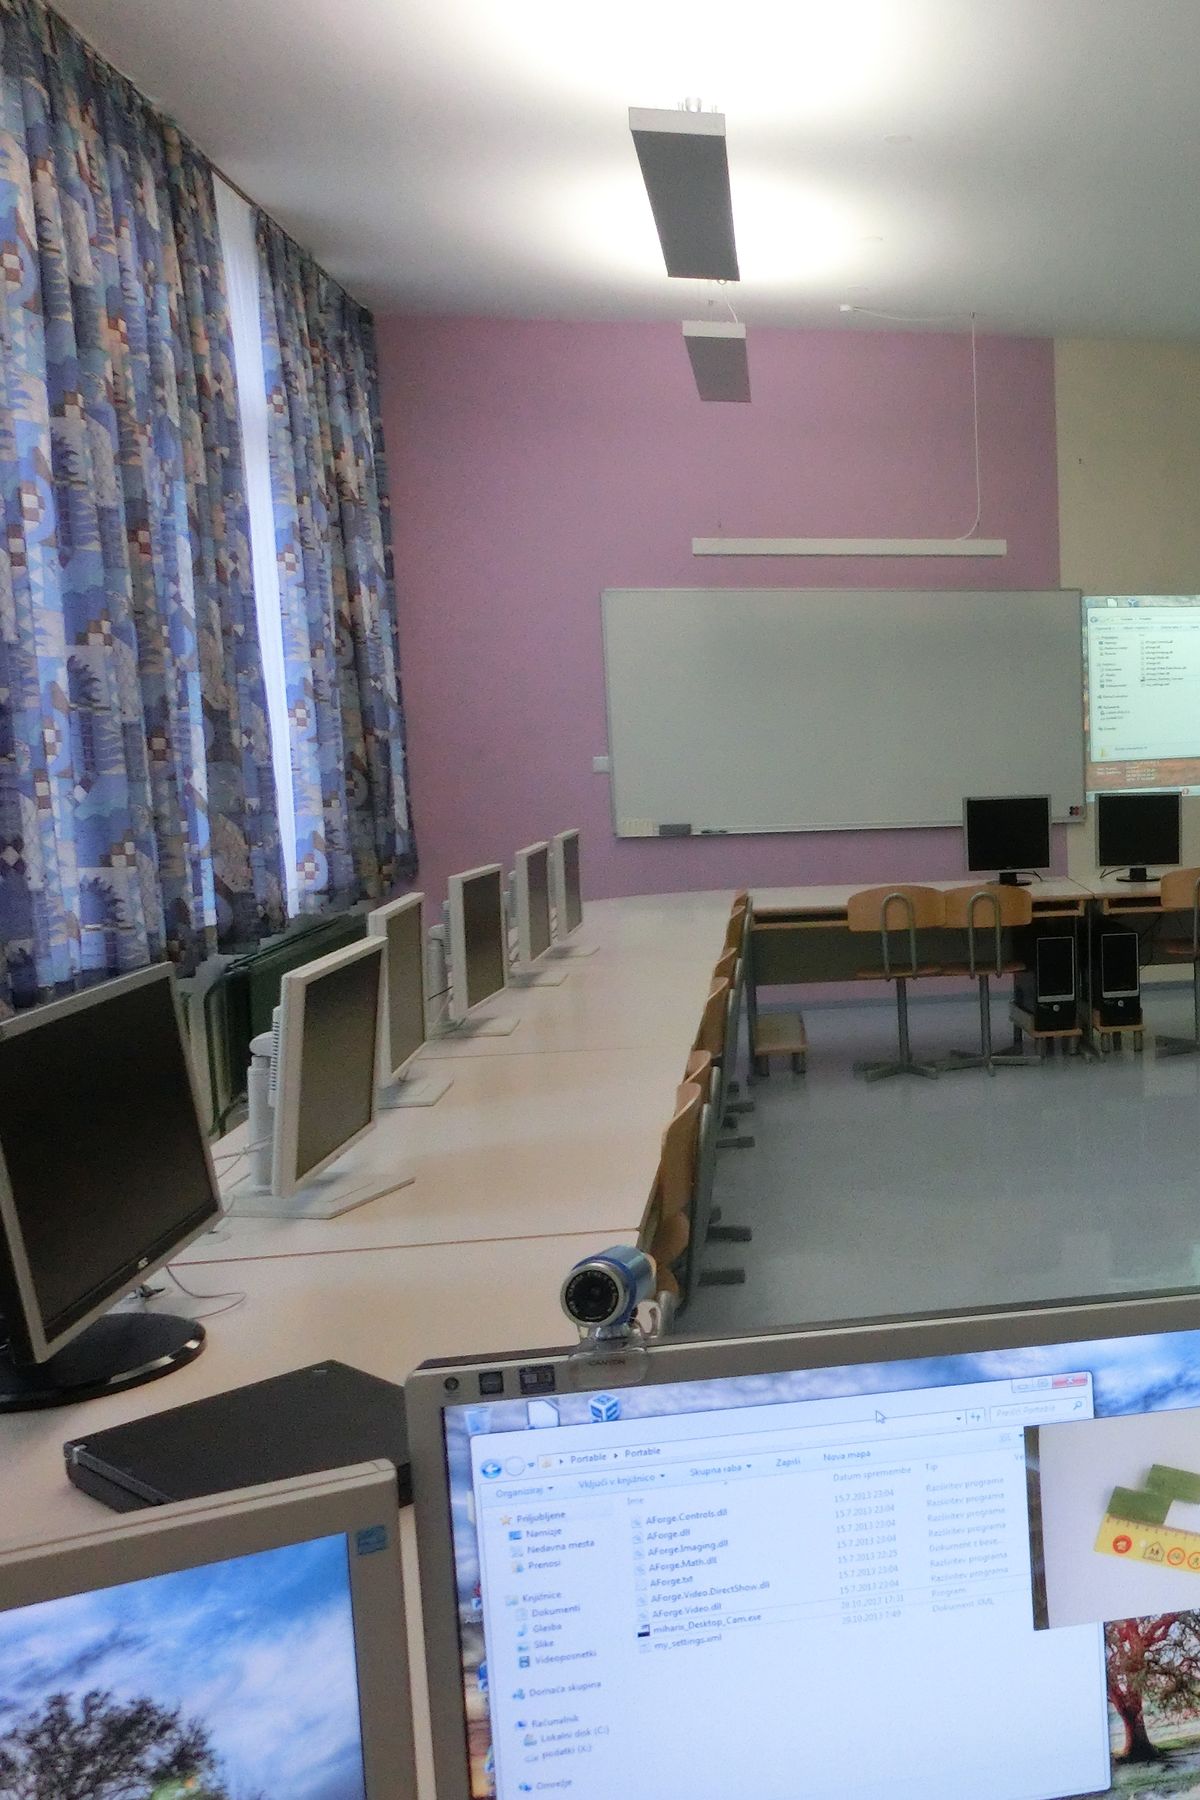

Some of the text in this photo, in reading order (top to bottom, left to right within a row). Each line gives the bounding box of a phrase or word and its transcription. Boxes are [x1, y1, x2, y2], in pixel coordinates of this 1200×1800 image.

[570, 1447, 661, 1465] Portable Portable
[847, 1450, 871, 1460] mapa
[690, 1465, 721, 1477] Skupna
[833, 1472, 862, 1482] Datum
[646, 1508, 728, 1525] AForge.Controls.dll
[646, 1528, 691, 1541] AForge.dll
[527, 1539, 595, 1554] Nedavna mesta
[648, 1539, 729, 1556] AForge.Imaging.dll
[649, 1556, 718, 1572] AForge.Math.dll
[650, 1575, 693, 1587] AForge.txt
[532, 1604, 581, 1617] Dokumenti
[535, 1650, 597, 1664] Videoposnetki
